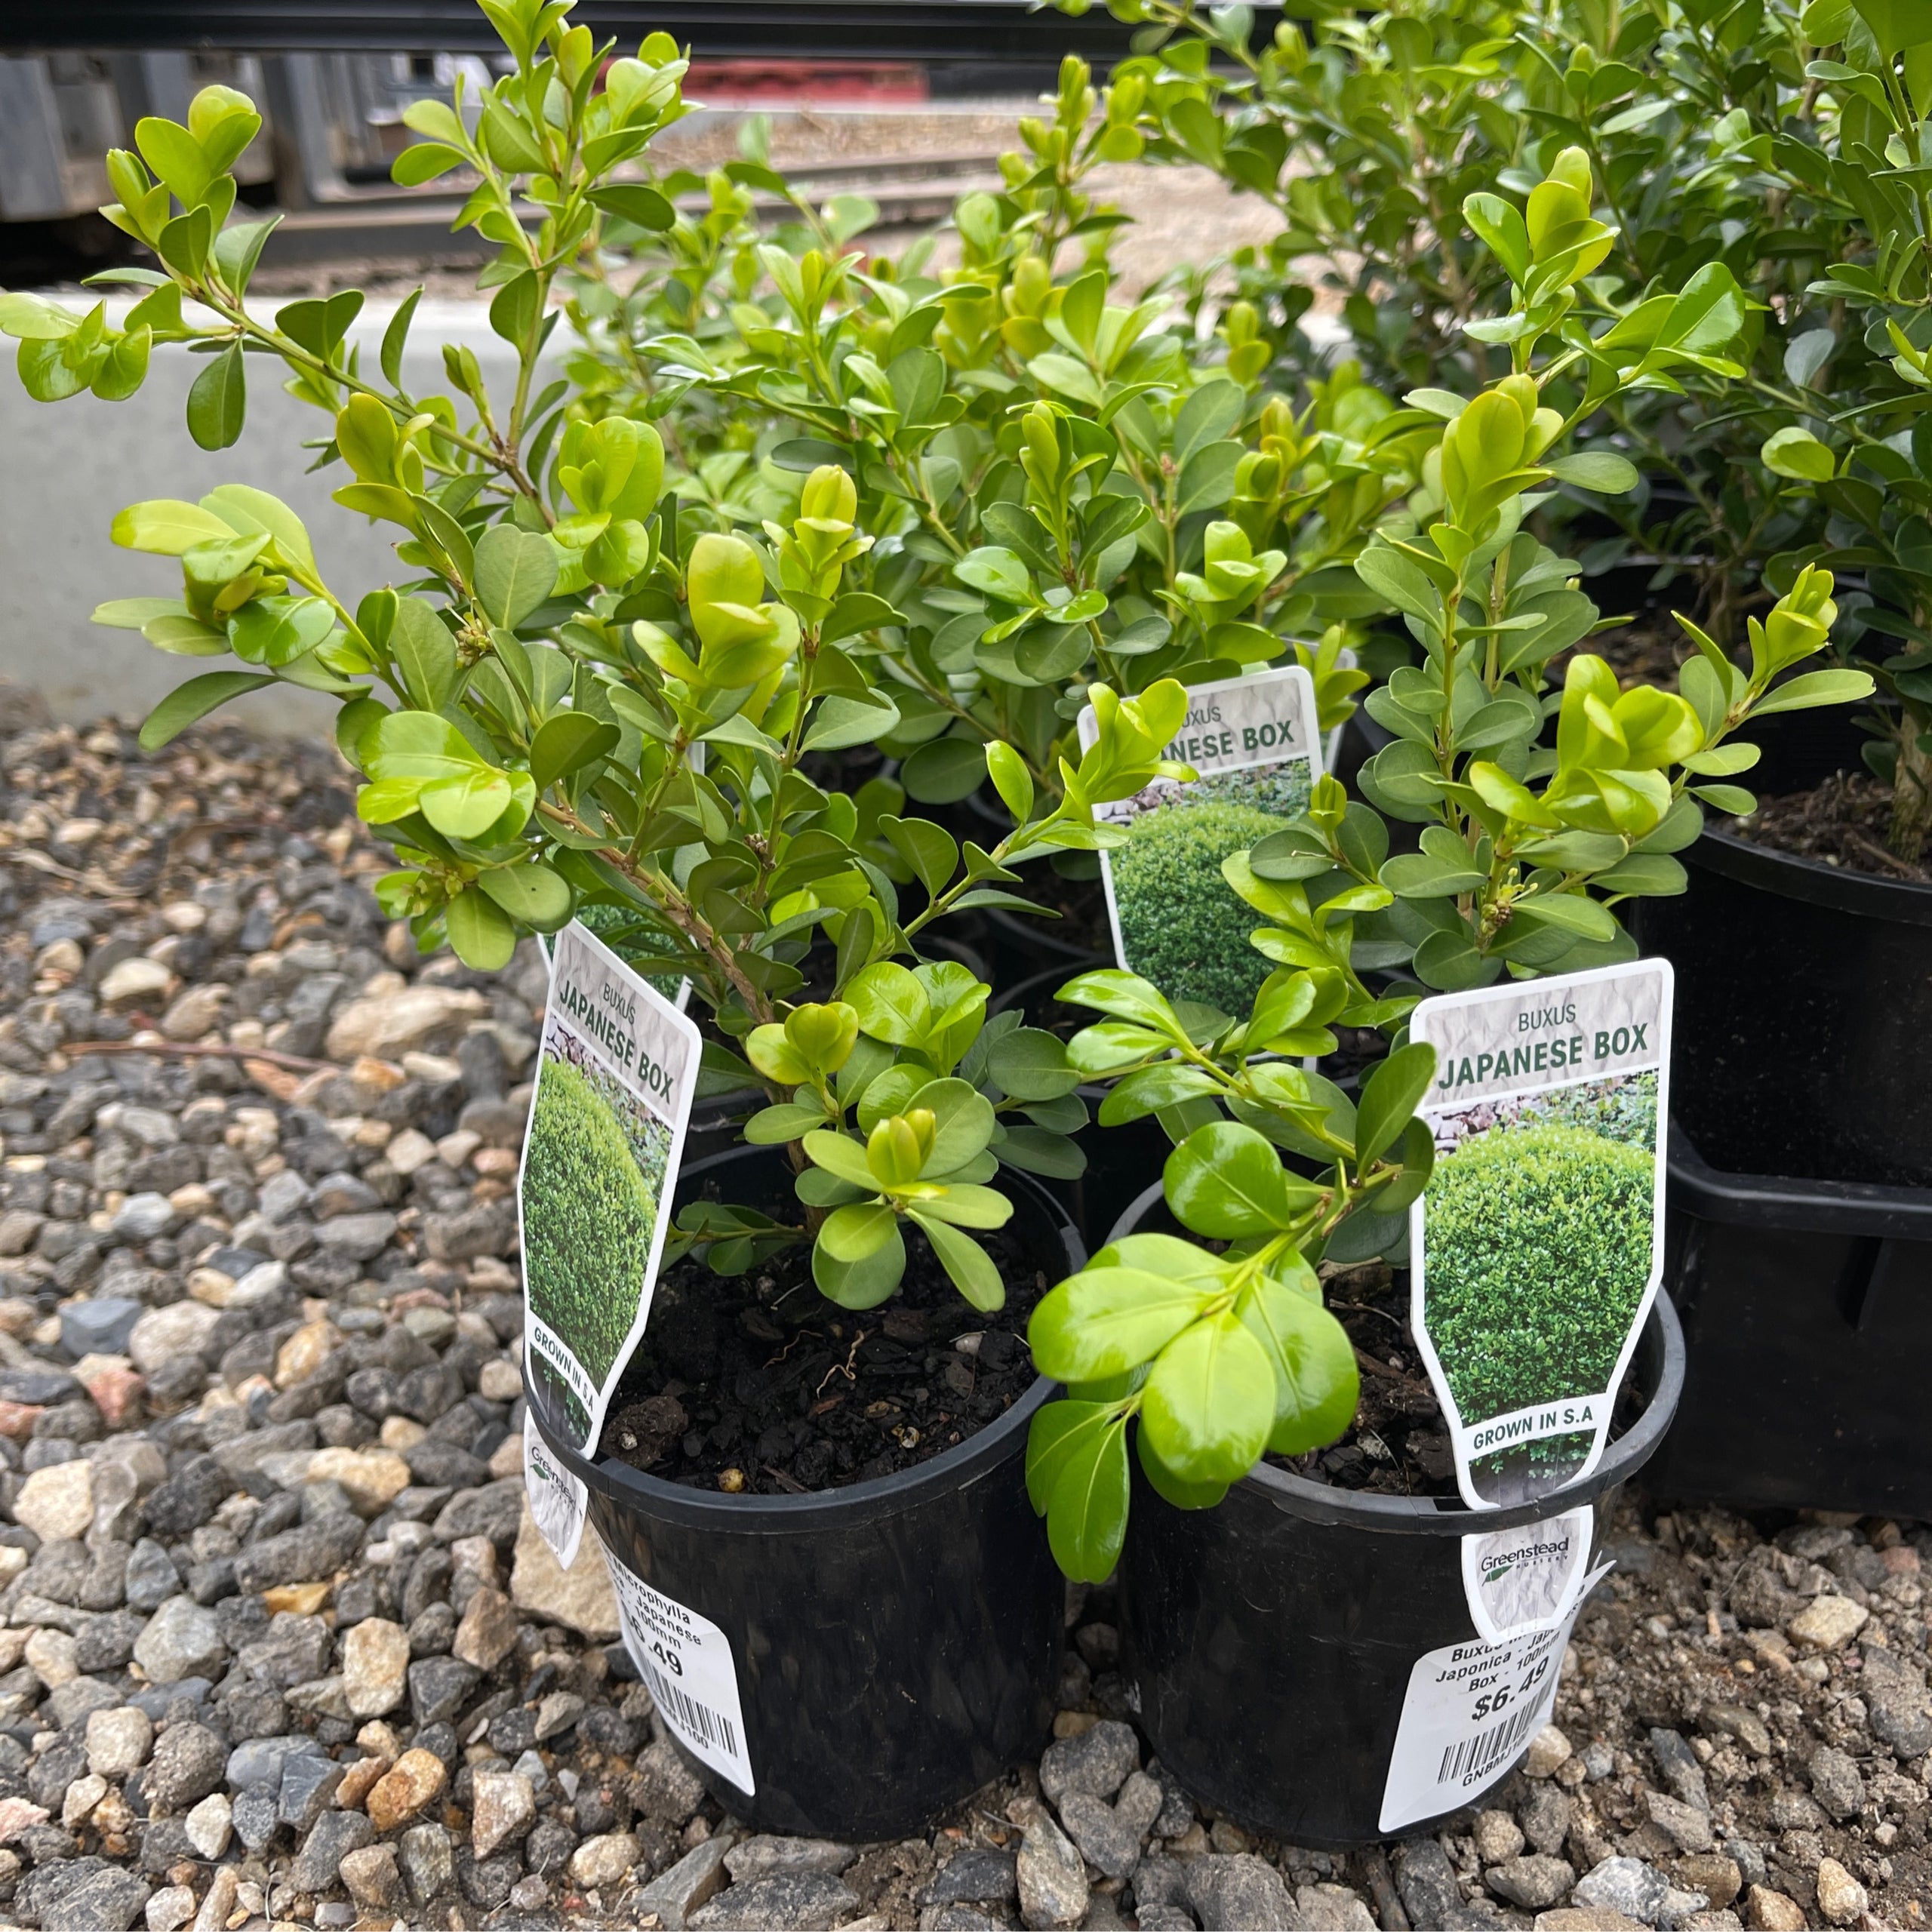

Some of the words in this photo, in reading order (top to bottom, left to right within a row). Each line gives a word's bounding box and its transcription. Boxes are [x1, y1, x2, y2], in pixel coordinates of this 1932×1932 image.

[1181, 706, 1222, 728] UXUS
[1161, 731, 1234, 763] NESE
[1242, 719, 1295, 752] BOX
[602, 982, 636, 1026] BUXUS
[1518, 1004, 1577, 1032] BUXUS
[558, 980, 635, 1069] JAPANESE
[638, 1051, 674, 1105] BOX
[1438, 1035, 1583, 1090] JAPANESE
[1594, 1023, 1648, 1060] BOX
[534, 1327, 572, 1374] GROWN
[572, 1367, 581, 1389] IN
[583, 1382, 593, 1412] S.A
[1473, 1416, 1534, 1451] GROWN
[1540, 1411, 1557, 1431] IN
[1563, 1405, 1594, 1426] S.A
[1481, 1537, 1569, 1572] Greenstead
[613, 1556, 691, 1625] Microphylla
[635, 1605, 681, 1650] 100mm
[636, 1595, 702, 1646] Japanese
[1436, 1651, 1512, 1682] Japonica
[1469, 1673, 1500, 1692] Box
[1517, 1631, 1561, 1671] 100mm
